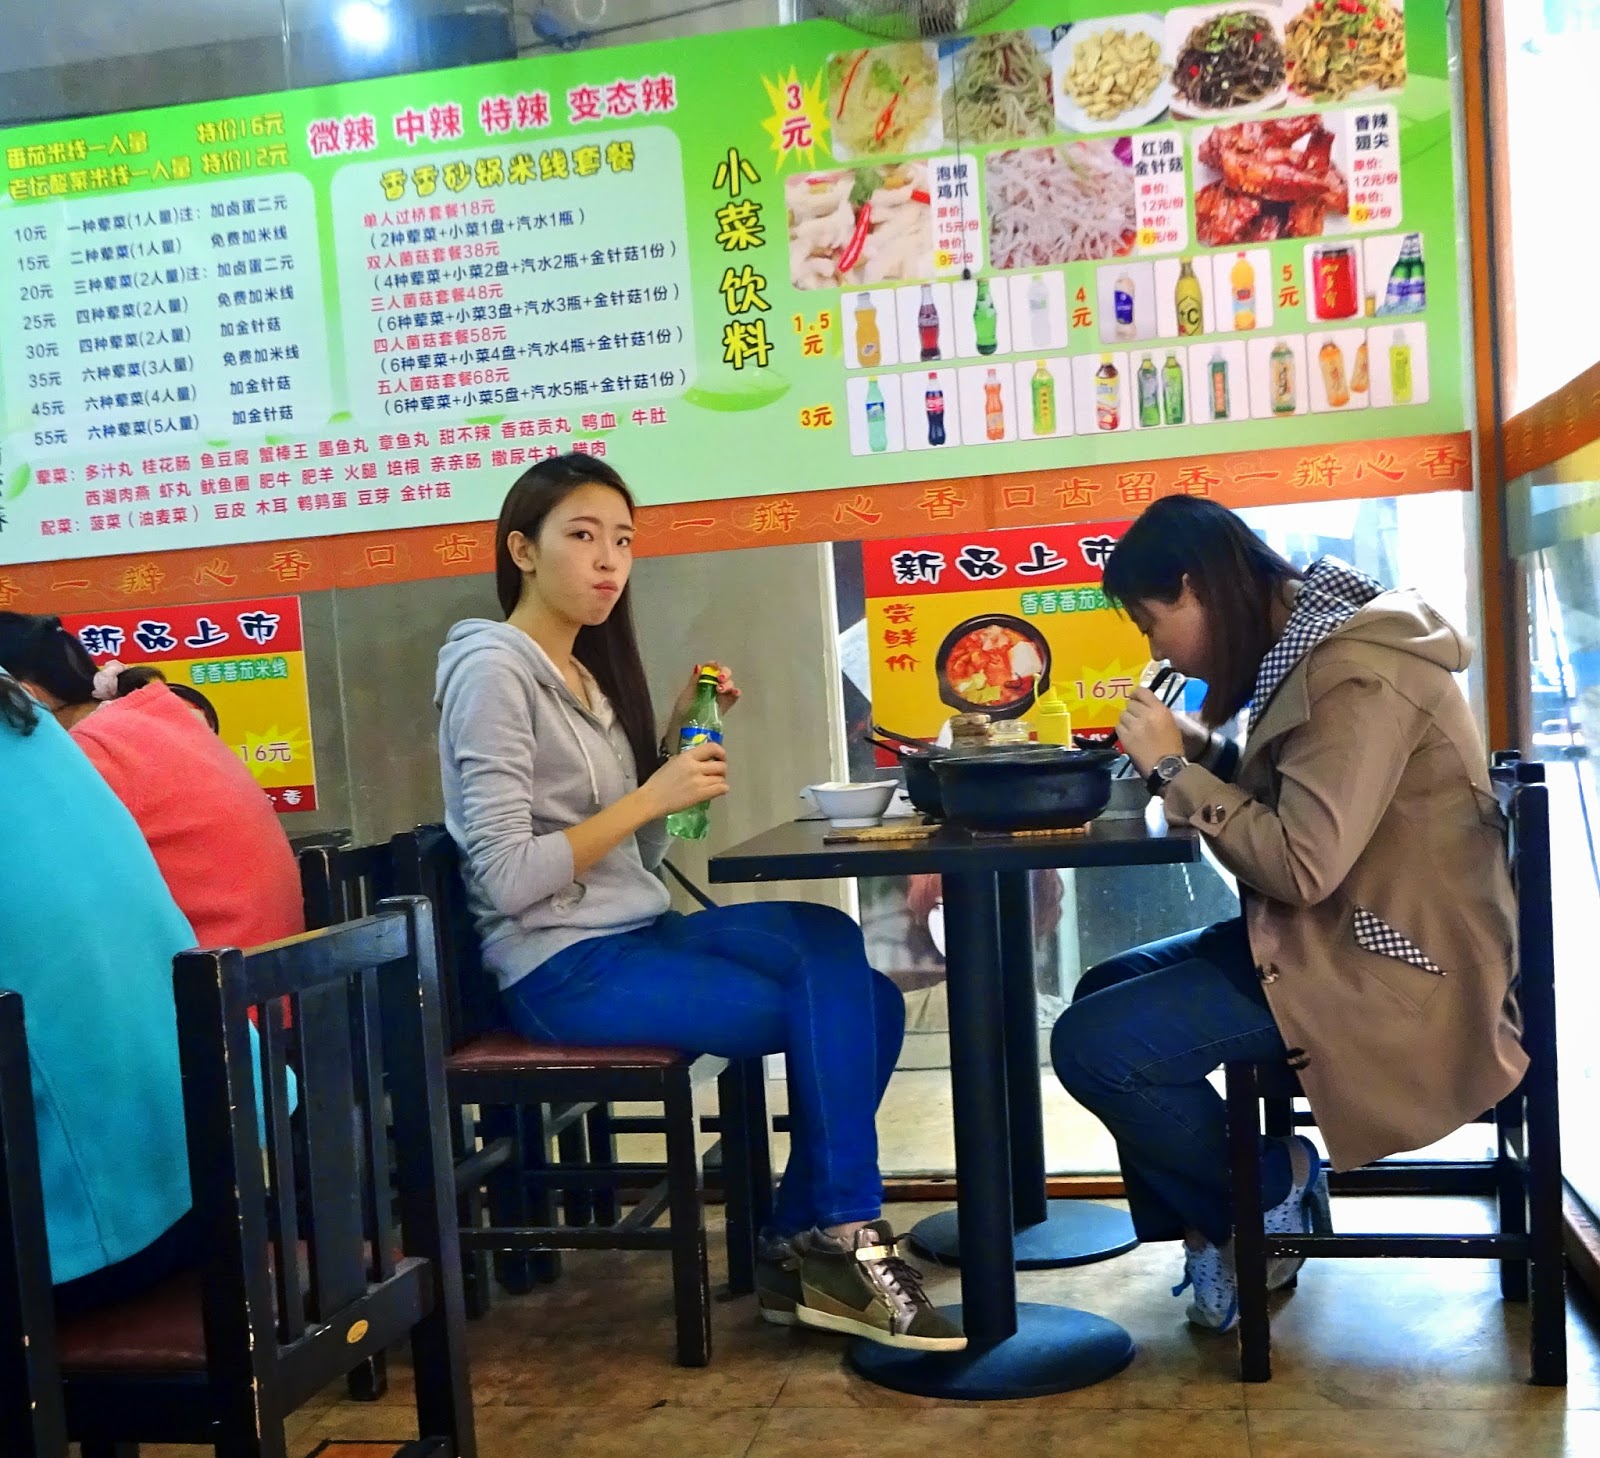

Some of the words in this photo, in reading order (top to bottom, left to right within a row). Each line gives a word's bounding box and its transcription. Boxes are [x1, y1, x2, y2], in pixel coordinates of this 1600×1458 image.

[308, 114, 376, 158] 微辣
[394, 103, 463, 146] 中辣
[479, 90, 551, 134] 特辣
[569, 75, 678, 123] 变态辣
[6, 131, 148, 169] 番茄米线一人量
[197, 112, 285, 144] 特价16元
[8, 156, 192, 200] 老坛酸菜米线一人量
[201, 144, 289, 176] 特价12元
[380, 140, 636, 200] 香香砂锅米线套餐
[364, 199, 496, 228] 单人过桥套餐18元
[712, 147, 765, 251] 小菜
[14, 225, 47, 243] 10元
[17, 255, 51, 272] 15元
[211, 225, 288, 248] 免费加米线
[367, 241, 500, 270] 双人菌菇套餐38元
[20, 284, 54, 301] 20元
[23, 314, 57, 331] 25元
[218, 285, 295, 308] 免费加米线
[370, 284, 504, 312] 三人菌菇套餐48元
[719, 265, 773, 369] 饮料
[26, 342, 60, 359] 30元
[220, 317, 281, 338] 加金针菇
[374, 326, 508, 354] 四人菌菇套餐58元
[803, 334, 824, 356] 元
[28, 372, 62, 388] 35元
[223, 344, 300, 367] 免费加米线
[377, 368, 511, 395] 五人菌菇套餐68元
[31, 400, 65, 417] 45元
[230, 376, 291, 395] 加金针菇
[801, 406, 833, 427] 3元
[34, 429, 68, 446] 55元
[232, 406, 294, 425] 加金针菇
[85, 463, 134, 481] 多汁丸
[142, 455, 190, 475] 桂花肠
[200, 449, 249, 469] 鱼豆腐
[259, 443, 309, 463] 蟹棒王
[318, 435, 368, 457] 墨鱼丸
[379, 428, 429, 450] 章鱼丸
[439, 424, 491, 446] 甜不辣
[501, 417, 571, 440] 香菇贡丸
[581, 412, 617, 431] 鸭血
[631, 407, 667, 425] 牛肚
[85, 485, 150, 507] 西湖肉燕
[159, 481, 191, 498] 虾丸
[200, 475, 250, 495] 鱿鱼圈
[259, 471, 291, 489] 肥牛
[301, 467, 334, 485] 肥羊
[344, 462, 377, 482] 火腿
[386, 457, 421, 477] 培根
[430, 451, 482, 473] 亲亲肠
[214, 502, 247, 520] 豆皮
[256, 497, 288, 516] 木耳
[297, 491, 348, 511] 鹌鹑蛋
[357, 488, 391, 506] 豆芽
[400, 482, 451, 502] 金针菇
[79, 610, 281, 656] 新品上市
[190, 657, 289, 685] 香香番茄米线
[1076, 677, 1134, 700] 16元
[241, 742, 292, 763] 16元
